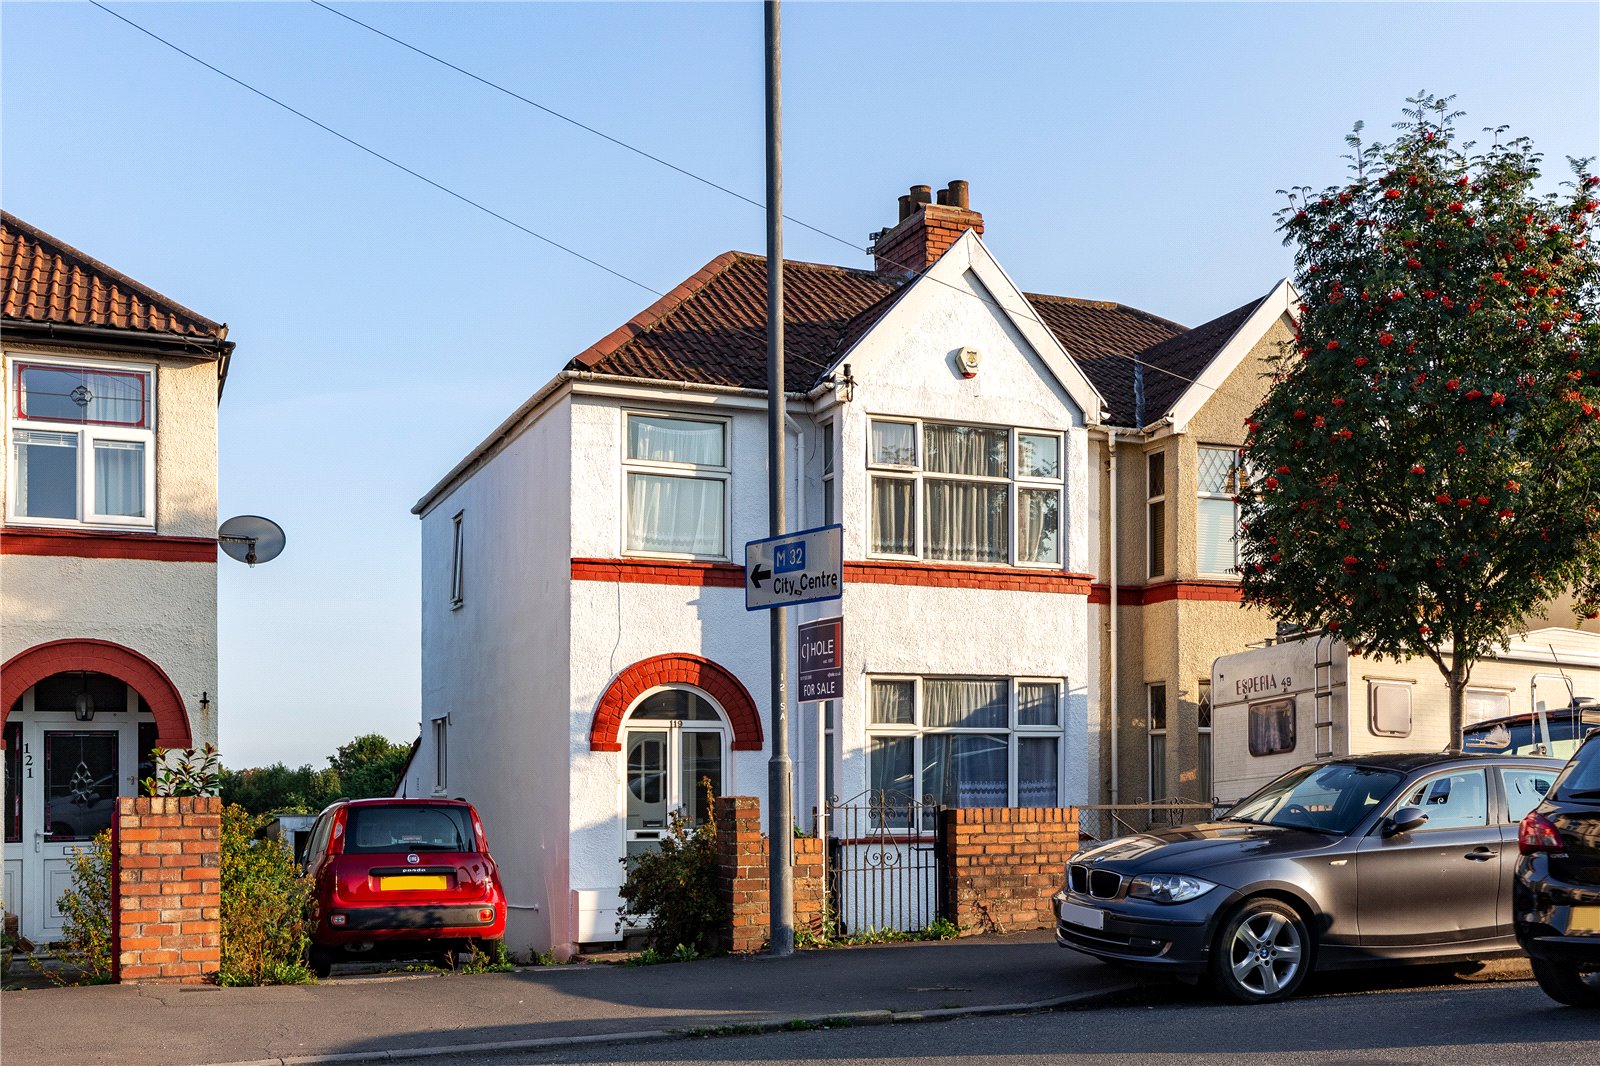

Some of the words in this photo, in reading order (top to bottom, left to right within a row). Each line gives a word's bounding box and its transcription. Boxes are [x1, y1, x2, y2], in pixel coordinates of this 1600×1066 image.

[776, 550, 786, 568] M
[789, 547, 803, 565] 32
[773, 577, 795, 596] City
[800, 570, 838, 591] Centre
[810, 639, 834, 657] HOLE
[803, 683, 815, 697] FOR
[816, 681, 835, 695] SALE
[1236, 673, 1277, 696] ESPERIA
[1281, 676, 1292, 687] 49
[669, 720, 683, 728] 119
[23, 742, 34, 779] 121
